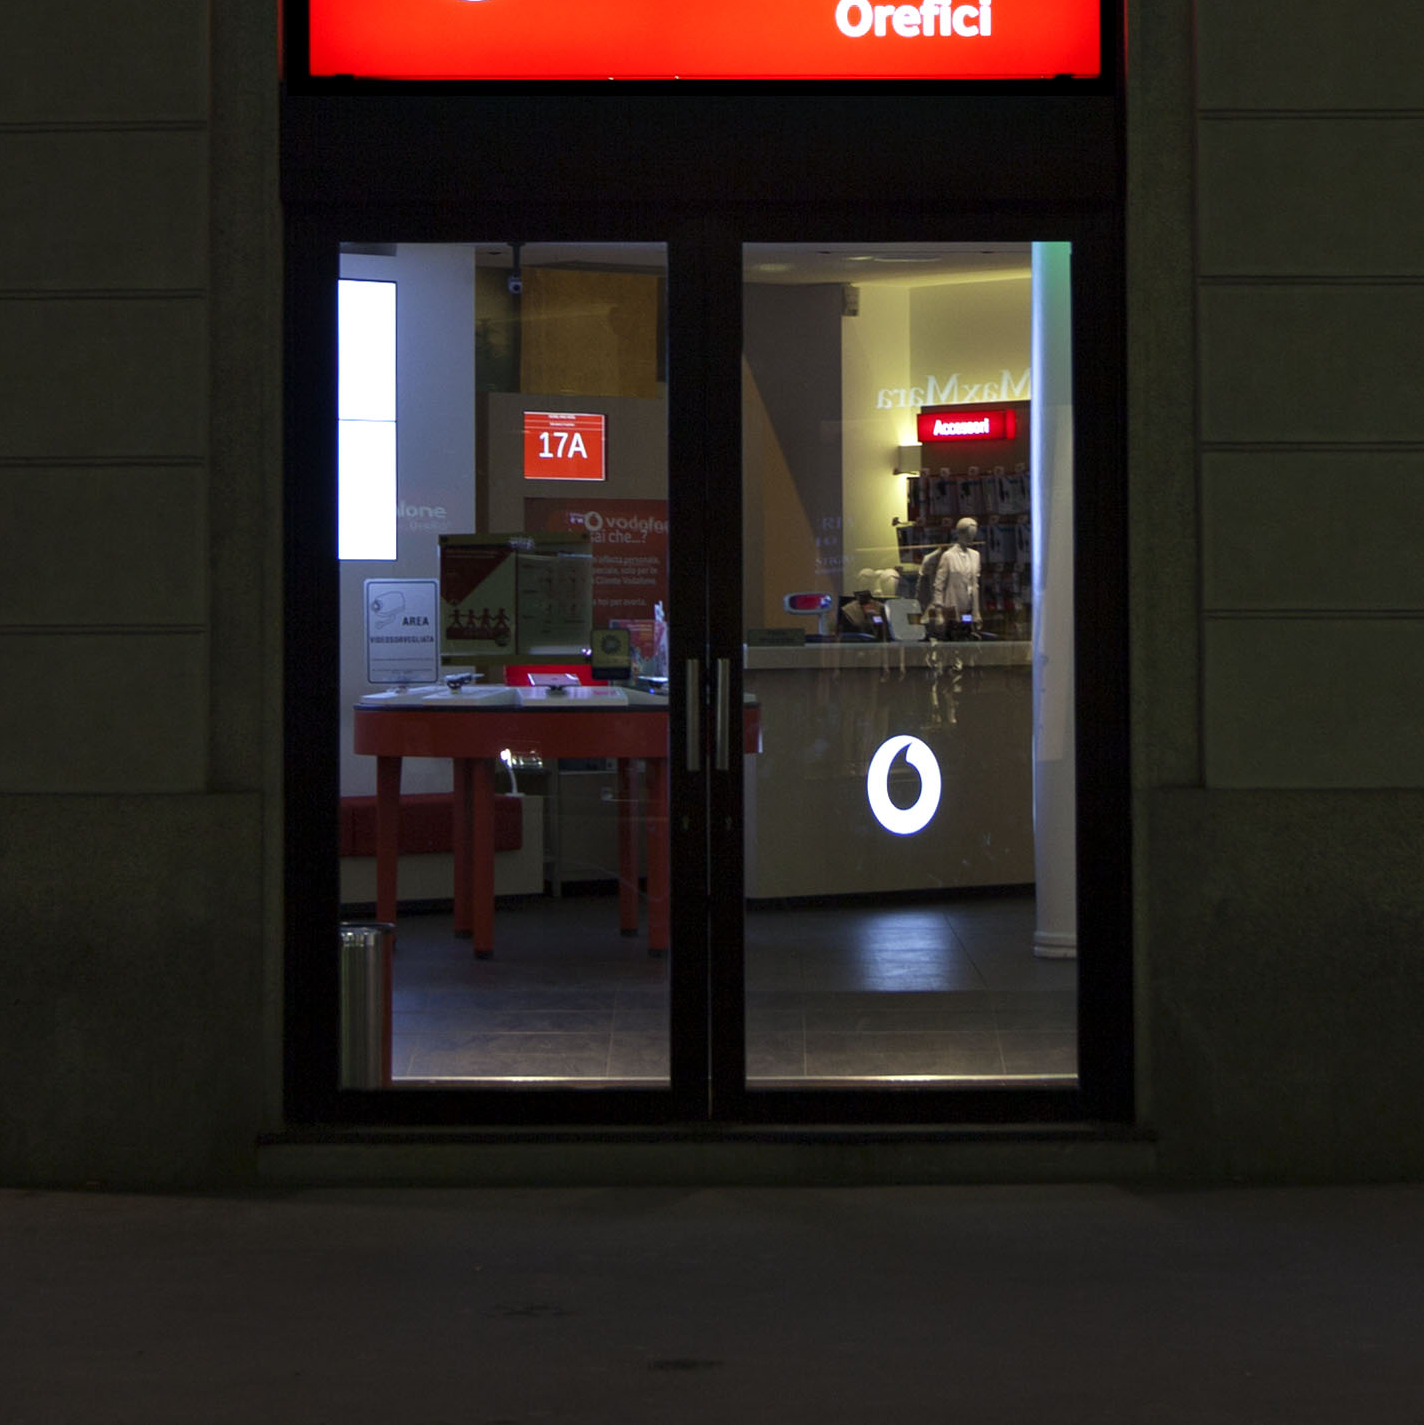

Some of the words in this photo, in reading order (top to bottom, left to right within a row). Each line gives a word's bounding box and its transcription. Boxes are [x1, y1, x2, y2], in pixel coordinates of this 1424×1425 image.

[933, 418, 990, 437] Accessori
[539, 431, 588, 459] 17A
[402, 616, 430, 626] AREA
